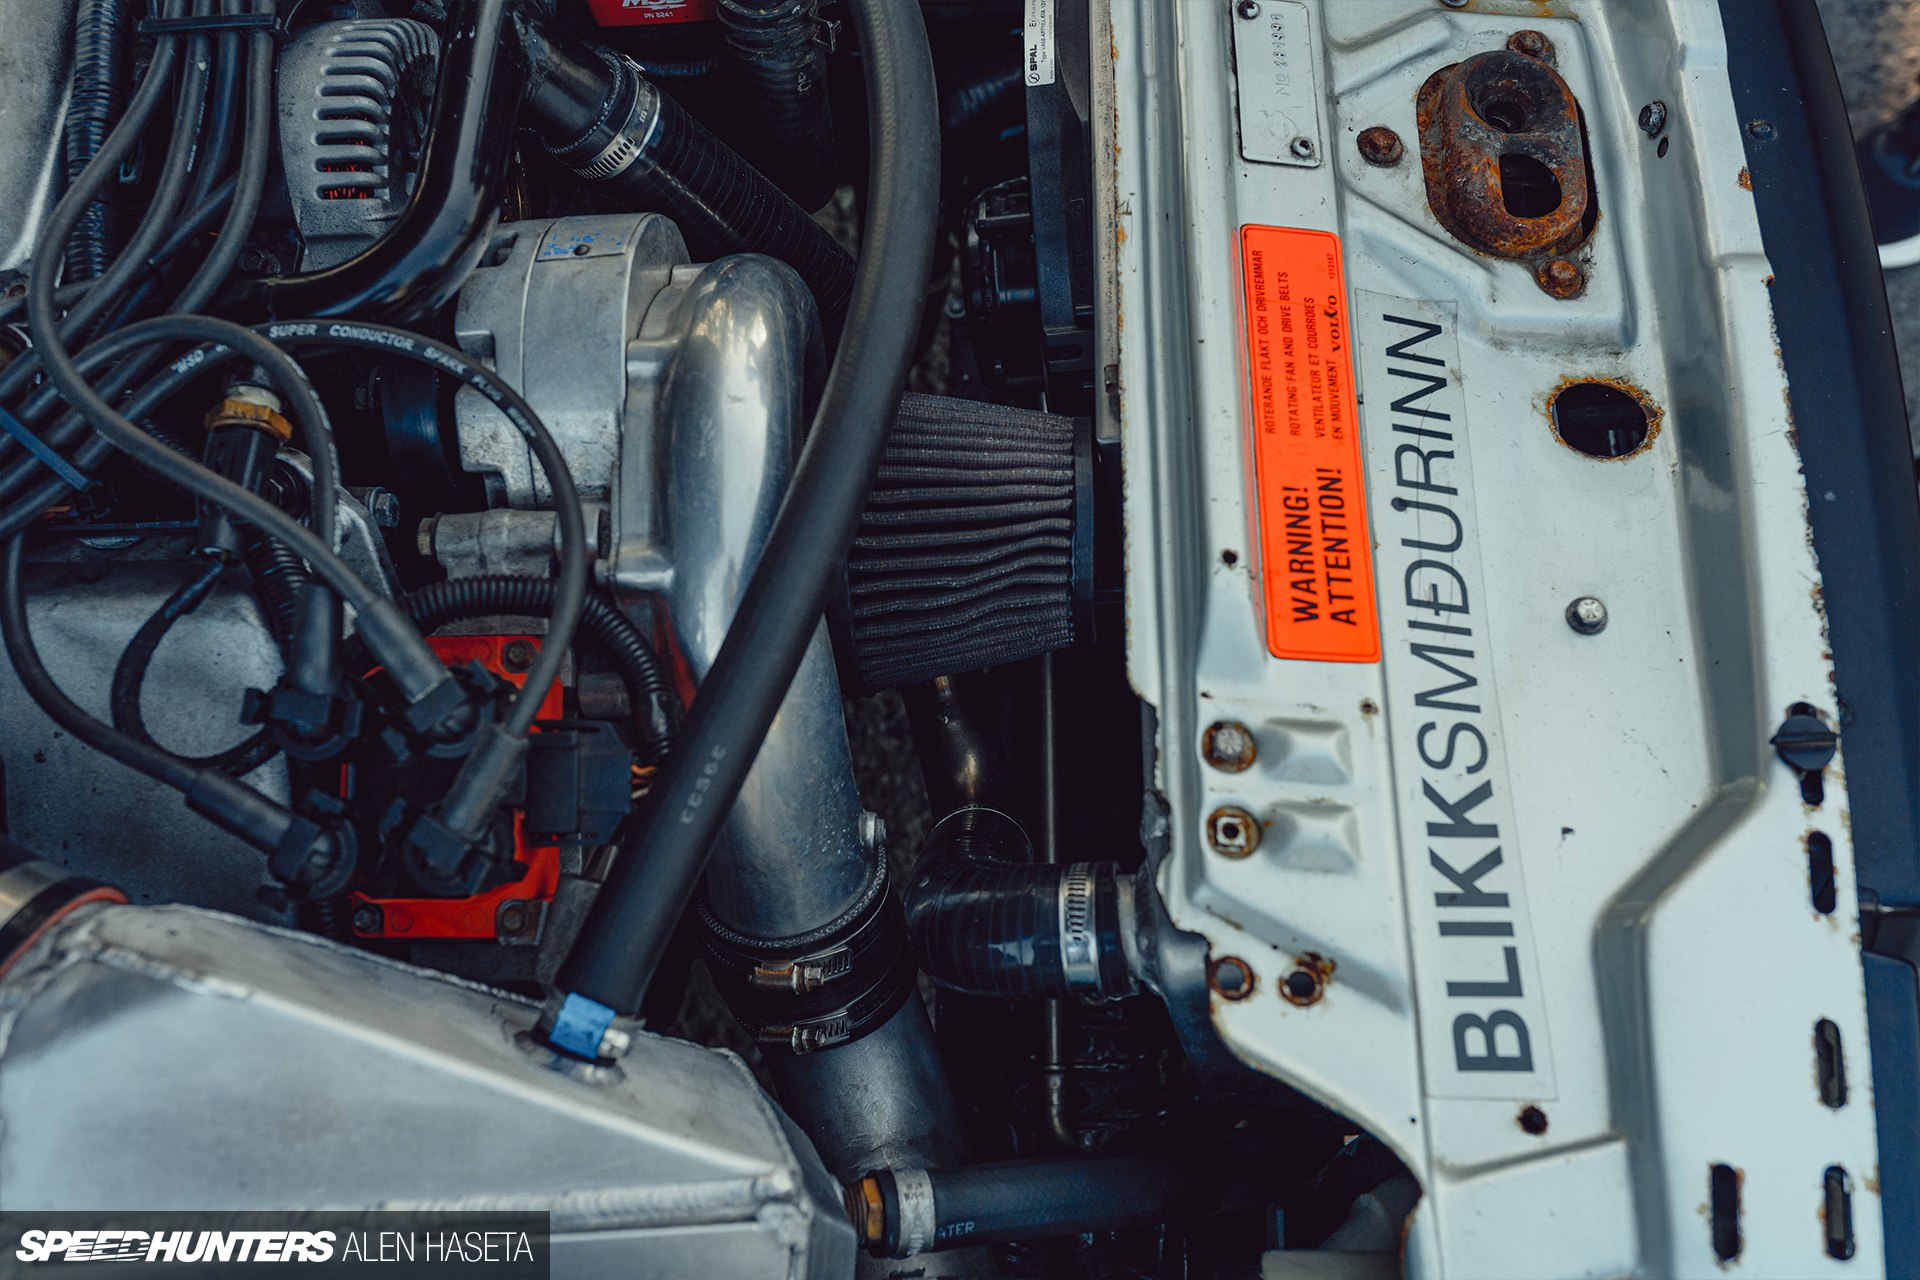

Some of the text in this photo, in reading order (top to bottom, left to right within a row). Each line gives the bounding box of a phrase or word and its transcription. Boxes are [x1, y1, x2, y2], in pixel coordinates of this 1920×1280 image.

[269, 324, 317, 338] SUPER
[329, 324, 415, 351] CONDUCTOR
[1252, 250, 1276, 434] ROTERANDE FLÄKT OCH DRIVREMMAR
[1278, 271, 1300, 436] ROTATING FAN AND DRIVE BELTS
[1304, 297, 1325, 438] VENTILATEUR ET COURROIES
[1328, 295, 1340, 352] VOLVO
[1326, 359, 1342, 439] EN MOUVEMENT
[1283, 487, 1319, 622] WARNING!
[1317, 468, 1356, 625] ATTENTION!
